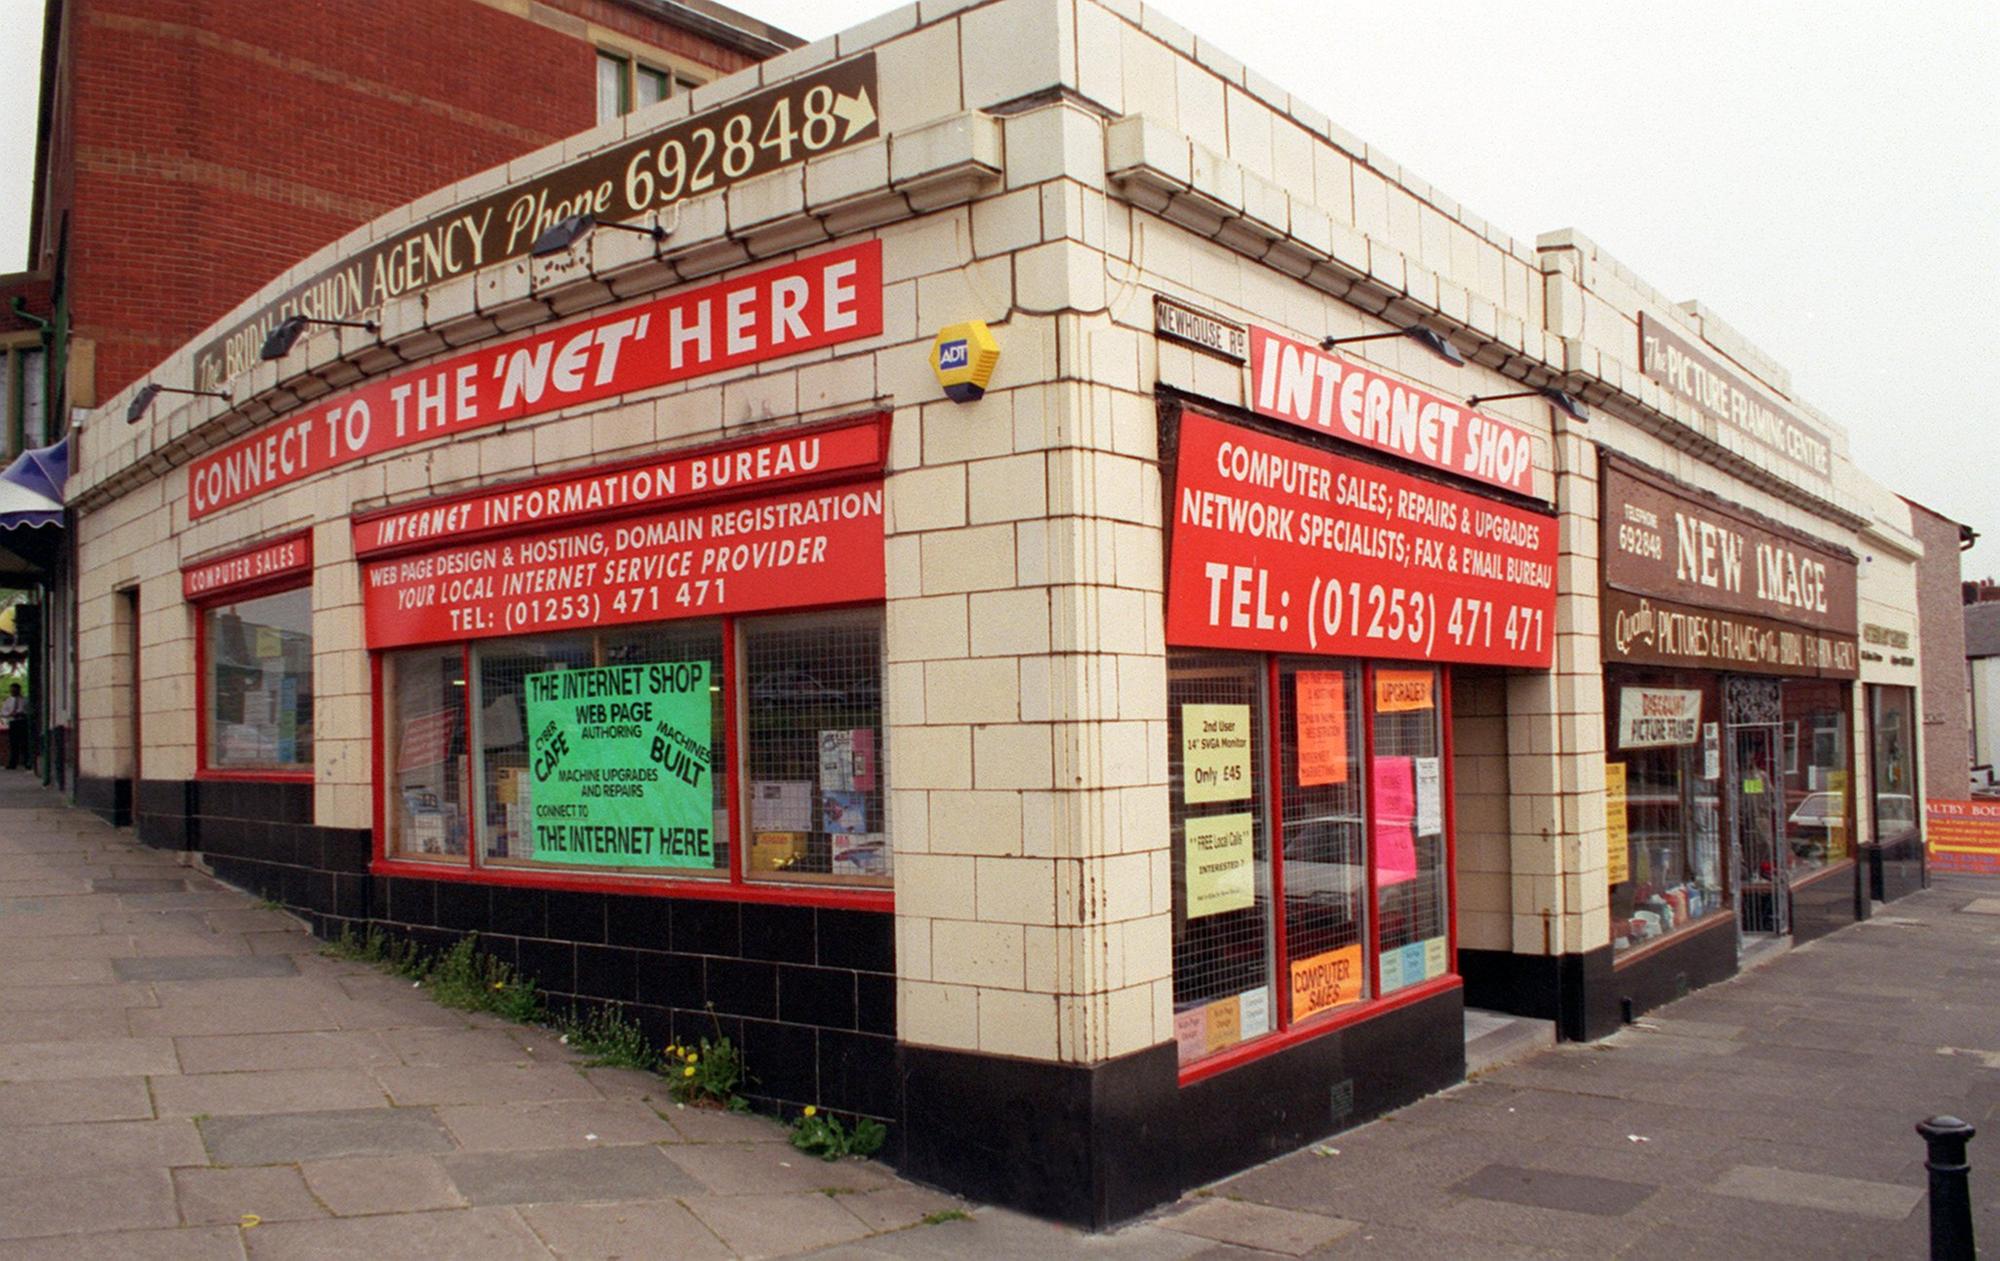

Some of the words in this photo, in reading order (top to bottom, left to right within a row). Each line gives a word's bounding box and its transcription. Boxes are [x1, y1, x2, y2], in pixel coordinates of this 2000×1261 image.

[371, 207, 493, 305] AGENCY
[506, 181, 613, 255] Phone
[625, 85, 837, 210] 692848
[1158, 303, 1223, 349] NEWHOUSE
[940, 344, 968, 364] ADT
[194, 420, 312, 511] CONNECT
[326, 399, 370, 458] TO
[391, 364, 478, 438] THE
[492, 313, 651, 410] 'NET'
[669, 259, 857, 370] HERE
[1667, 344, 1729, 418] PICTURE
[1259, 336, 1460, 465] INTERNET
[1464, 416, 1530, 487] SHOP
[377, 503, 471, 545] INTERNET
[484, 466, 676, 527] INFORMATION
[690, 438, 820, 490] BUREAU
[1217, 441, 1331, 501] COMPUTER
[1398, 488, 1457, 531] REPAIRS
[1461, 509, 1471, 534] &
[1475, 511, 1540, 550] UPGRADES
[371, 565, 397, 588] WEB
[401, 558, 433, 583] PAGE
[436, 549, 497, 577] DESIGN
[502, 546, 514, 567] &
[520, 532, 609, 565] HOSTING,
[615, 516, 703, 551] DOMAIN
[711, 489, 883, 538] REGISTRATION
[1181, 488, 1293, 543] NETWORK
[1415, 538, 1443, 570] FAX
[1447, 548, 1458, 573] &
[1506, 557, 1552, 590] BUREAU
[1620, 524, 1662, 560] 692848
[191, 558, 250, 592] COMPUTER
[256, 544, 295, 575] SALES
[398, 583, 435, 610] YOUR
[440, 576, 494, 603] LOCAL
[502, 562, 597, 596] INTERNET
[603, 550, 693, 585] SERVICE
[701, 535, 828, 575] PROVIDER
[1675, 512, 1744, 593] NEW
[1756, 543, 1828, 613] IMAGE
[450, 607, 494, 631] TEL:
[505, 594, 601, 631] (01253)
[612, 586, 659, 614] 471
[675, 578, 725, 607] 471
[1205, 562, 1290, 633] TEL:
[1308, 576, 1437, 657] (01253)
[1447, 596, 1492, 648] 471
[1505, 605, 1543, 653] 471
[1658, 610, 1709, 657] PICTURES
[1721, 620, 1759, 662] FRAMES
[530, 673, 559, 702] THE
[562, 667, 644, 699] INTERNET
[649, 664, 703, 694] SHOP
[1382, 682, 1425, 704] UPGRADES
[535, 720, 557, 751] CYBER
[576, 704, 607, 724] WEB
[611, 702, 653, 722] PAGE
[581, 725, 642, 739] AUTHORING
[1203, 720, 1217, 732] 2nd
[1219, 720, 1235, 732] User
[534, 731, 570, 782] CAFE
[650, 735, 706, 788] BUILT
[656, 720, 712, 764] MACHINES
[1201, 738, 1219, 749] SVGA
[1221, 736, 1246, 748] Monitor
[558, 769, 600, 782] MACHINE
[602, 768, 658, 782] UPGRADES
[581, 785, 601, 797] AND
[603, 784, 644, 797] REPAIRS
[1195, 766, 1217, 786] Only
[1223, 765, 1241, 781] £45
[536, 804, 577, 817] CONNECT
[577, 804, 589, 817] TO
[537, 825, 567, 851] THE
[569, 826, 654, 854] INTERNET
[659, 827, 711, 856] HERE
[1294, 959, 1350, 994] COMPUTER
[1308, 984, 1341, 1012] SALES
